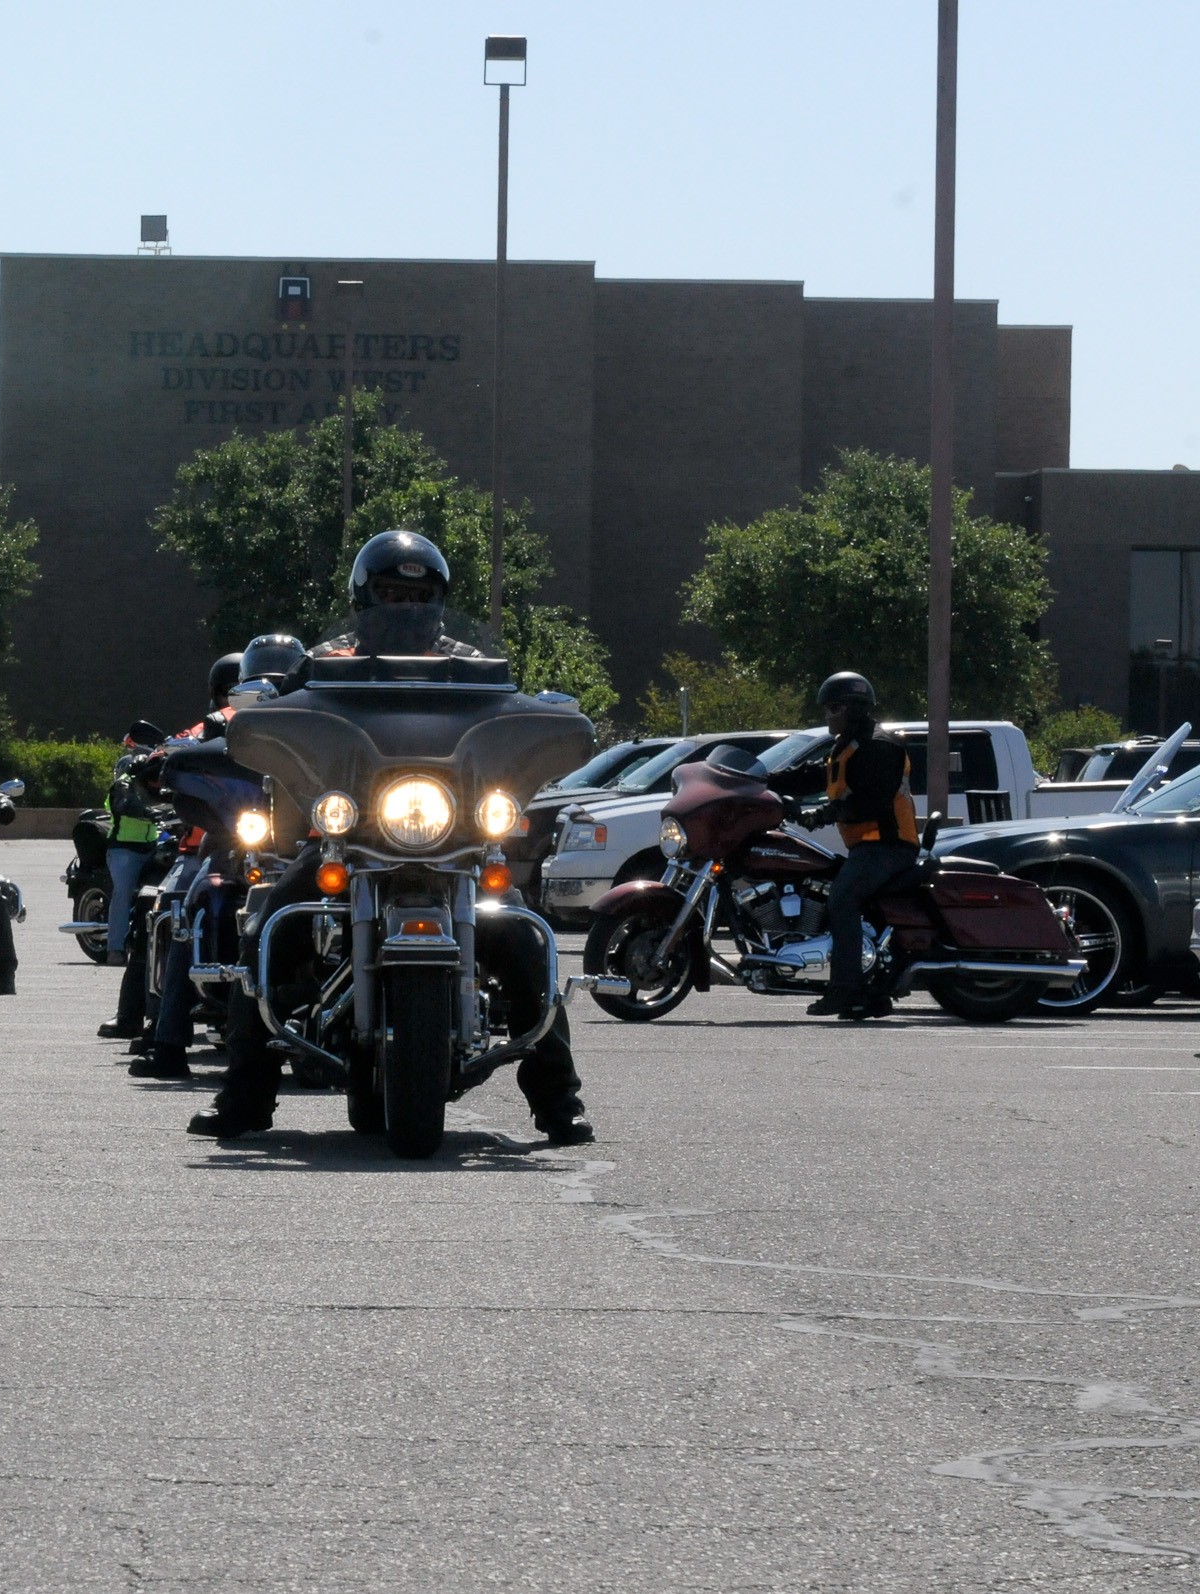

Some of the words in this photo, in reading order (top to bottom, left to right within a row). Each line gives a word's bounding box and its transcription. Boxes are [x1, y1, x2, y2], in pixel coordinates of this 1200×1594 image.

[127, 331, 461, 361] HEADQUARTERS
[161, 368, 312, 391] DIVISION
[184, 401, 287, 424] FIRST
